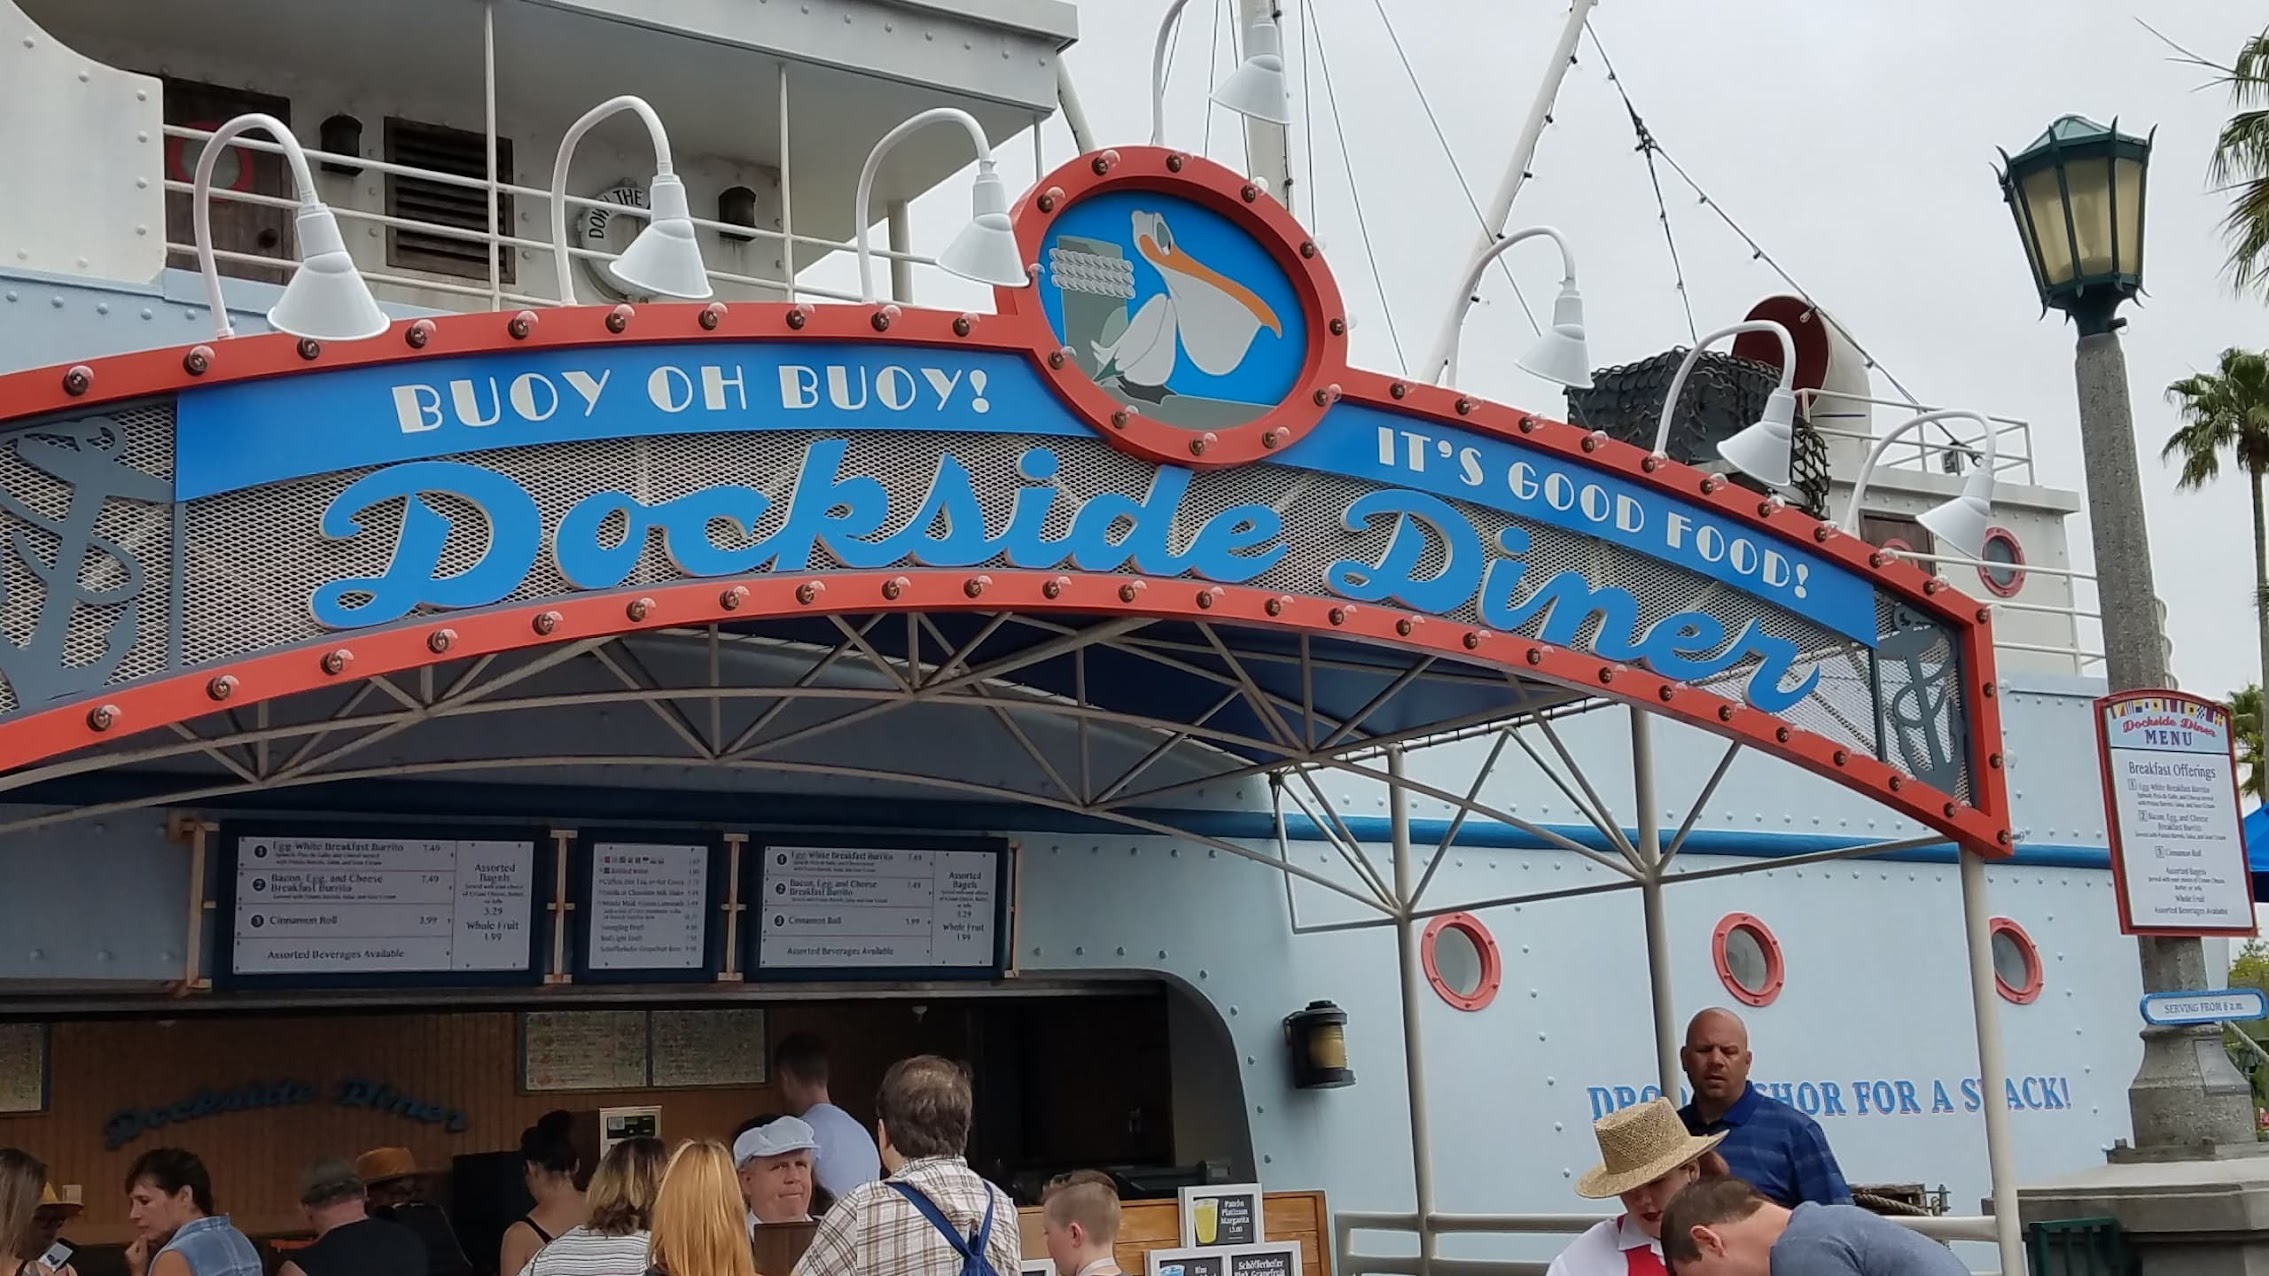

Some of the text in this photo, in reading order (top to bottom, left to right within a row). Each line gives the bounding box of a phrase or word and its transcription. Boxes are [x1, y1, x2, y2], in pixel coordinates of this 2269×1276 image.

[612, 188, 643, 206] THE
[391, 364, 990, 434] BUOY OH BUOY!
[1377, 425, 1810, 599] IT'S GOOD FOOD!
[311, 438, 1820, 714] Dockside Diner
[2123, 716, 2216, 737] Dockside Diner
[2145, 730, 2192, 746] MENU
[2129, 762, 2215, 781] Breakfast Offerings
[325, 842, 369, 851] Breakfast
[475, 864, 516, 872] Assorted
[330, 874, 346, 882] and
[268, 949, 404, 961] Assorted Beverages Available
[2165, 1003, 2198, 1014] SERVING
[2200, 1002, 2222, 1012] FROM
[1852, 1080, 1921, 1116] FOR
[1931, 1079, 1954, 1114] A
[1960, 1076, 2072, 1113] SACK!
[1220, 1217, 1250, 1225] Margarita
